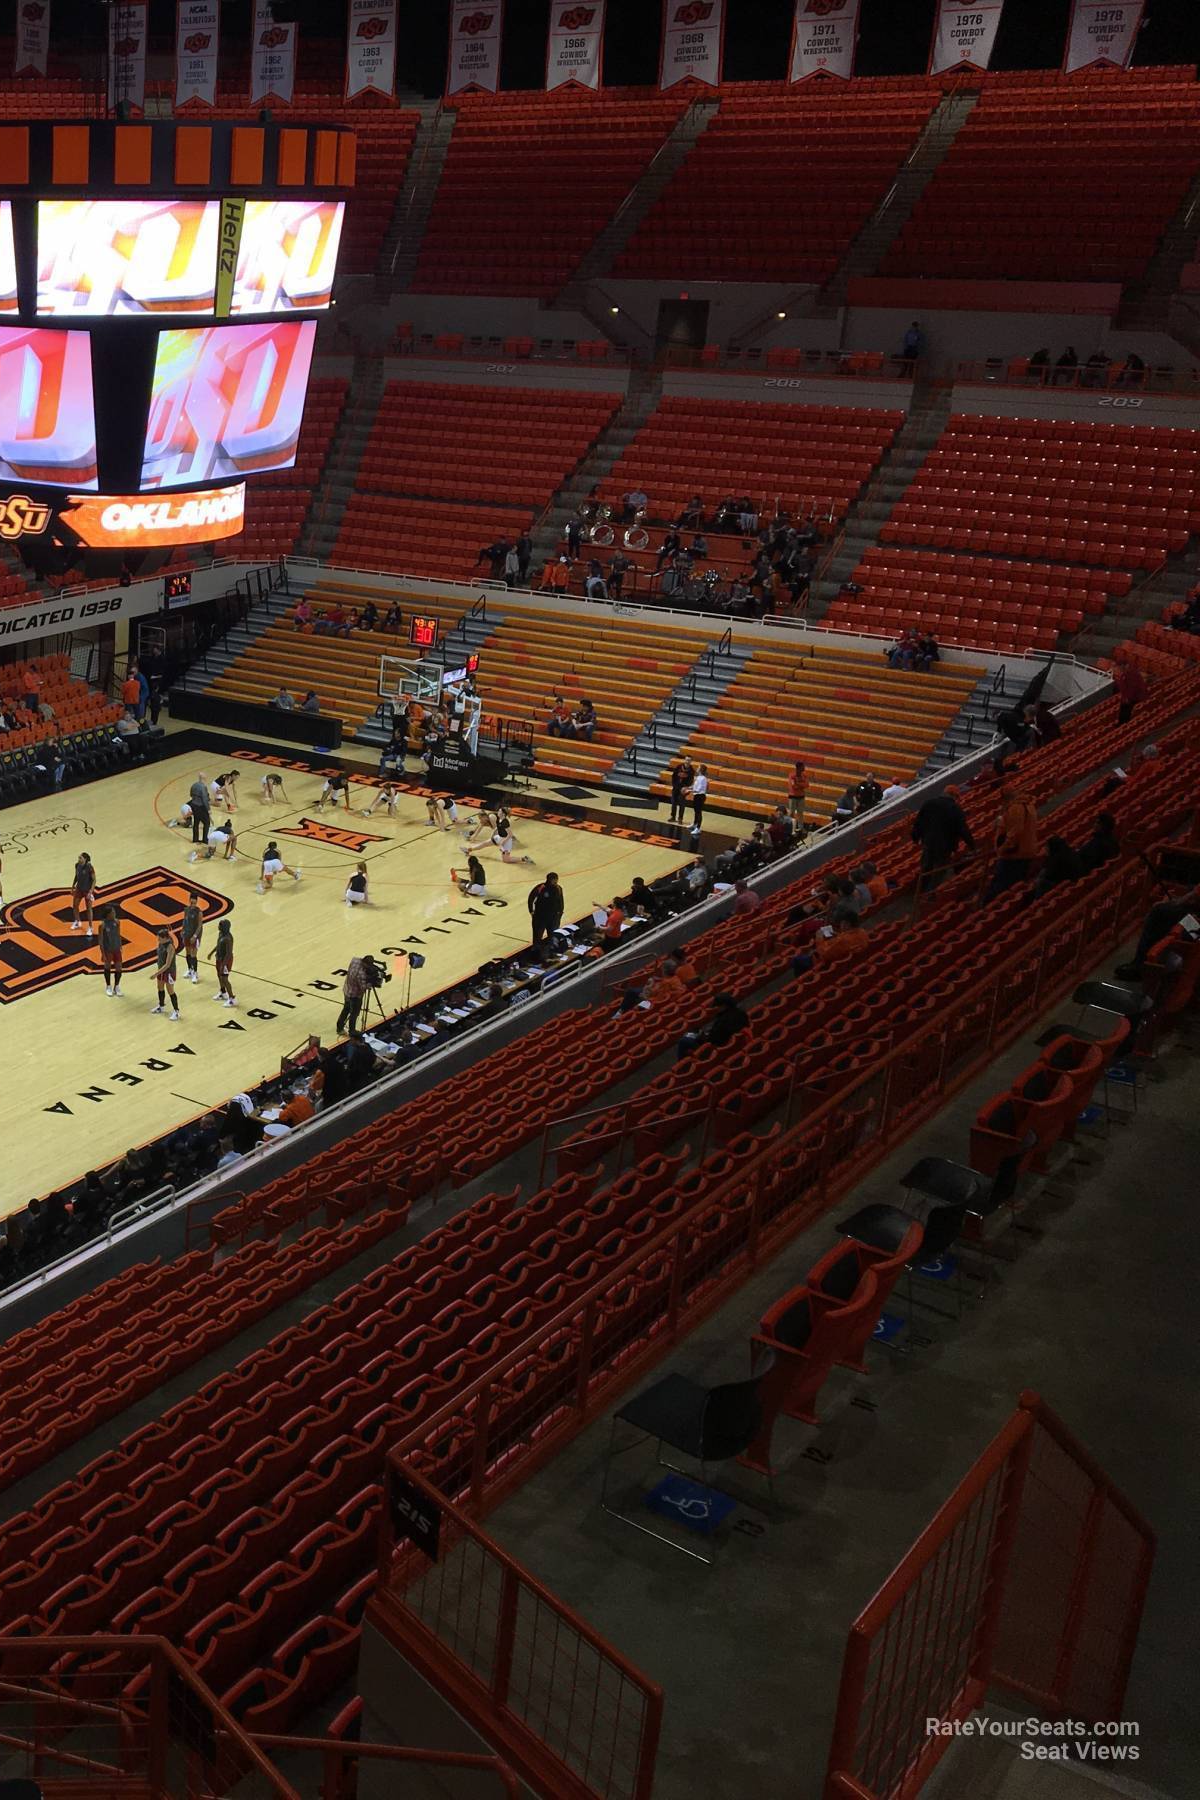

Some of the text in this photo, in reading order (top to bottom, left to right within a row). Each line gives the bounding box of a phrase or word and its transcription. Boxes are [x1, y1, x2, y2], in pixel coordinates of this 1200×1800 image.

[956, 14, 983, 26] 1976
[812, 24, 836, 36] 1971
[950, 27, 986, 38] COWBOY
[1087, 23, 1126, 34] COWBOY
[564, 38, 586, 49] 1966
[681, 33, 704, 45] 1968
[806, 37, 840, 48] COWBOY
[957, 37, 976, 47] GOLF
[1095, 34, 1116, 43] GOLF
[362, 47, 380, 57] 1963
[559, 50, 588, 59] COWBOY
[676, 45, 707, 56] COWBOY
[803, 46, 843, 56] WRESTLING
[219, 200, 242, 275] Hertz
[486, 363, 517, 374] 207
[765, 377, 801, 389] 208
[1098, 395, 1144, 408] 209
[78, 597, 124, 618] 1938
[416, 628, 433, 643] 30
[510, 806, 681, 848] STATE
[42, 1043, 197, 1115] ARENA
[802, 1446, 834, 1465] 12
[733, 1518, 766, 1538] 13
